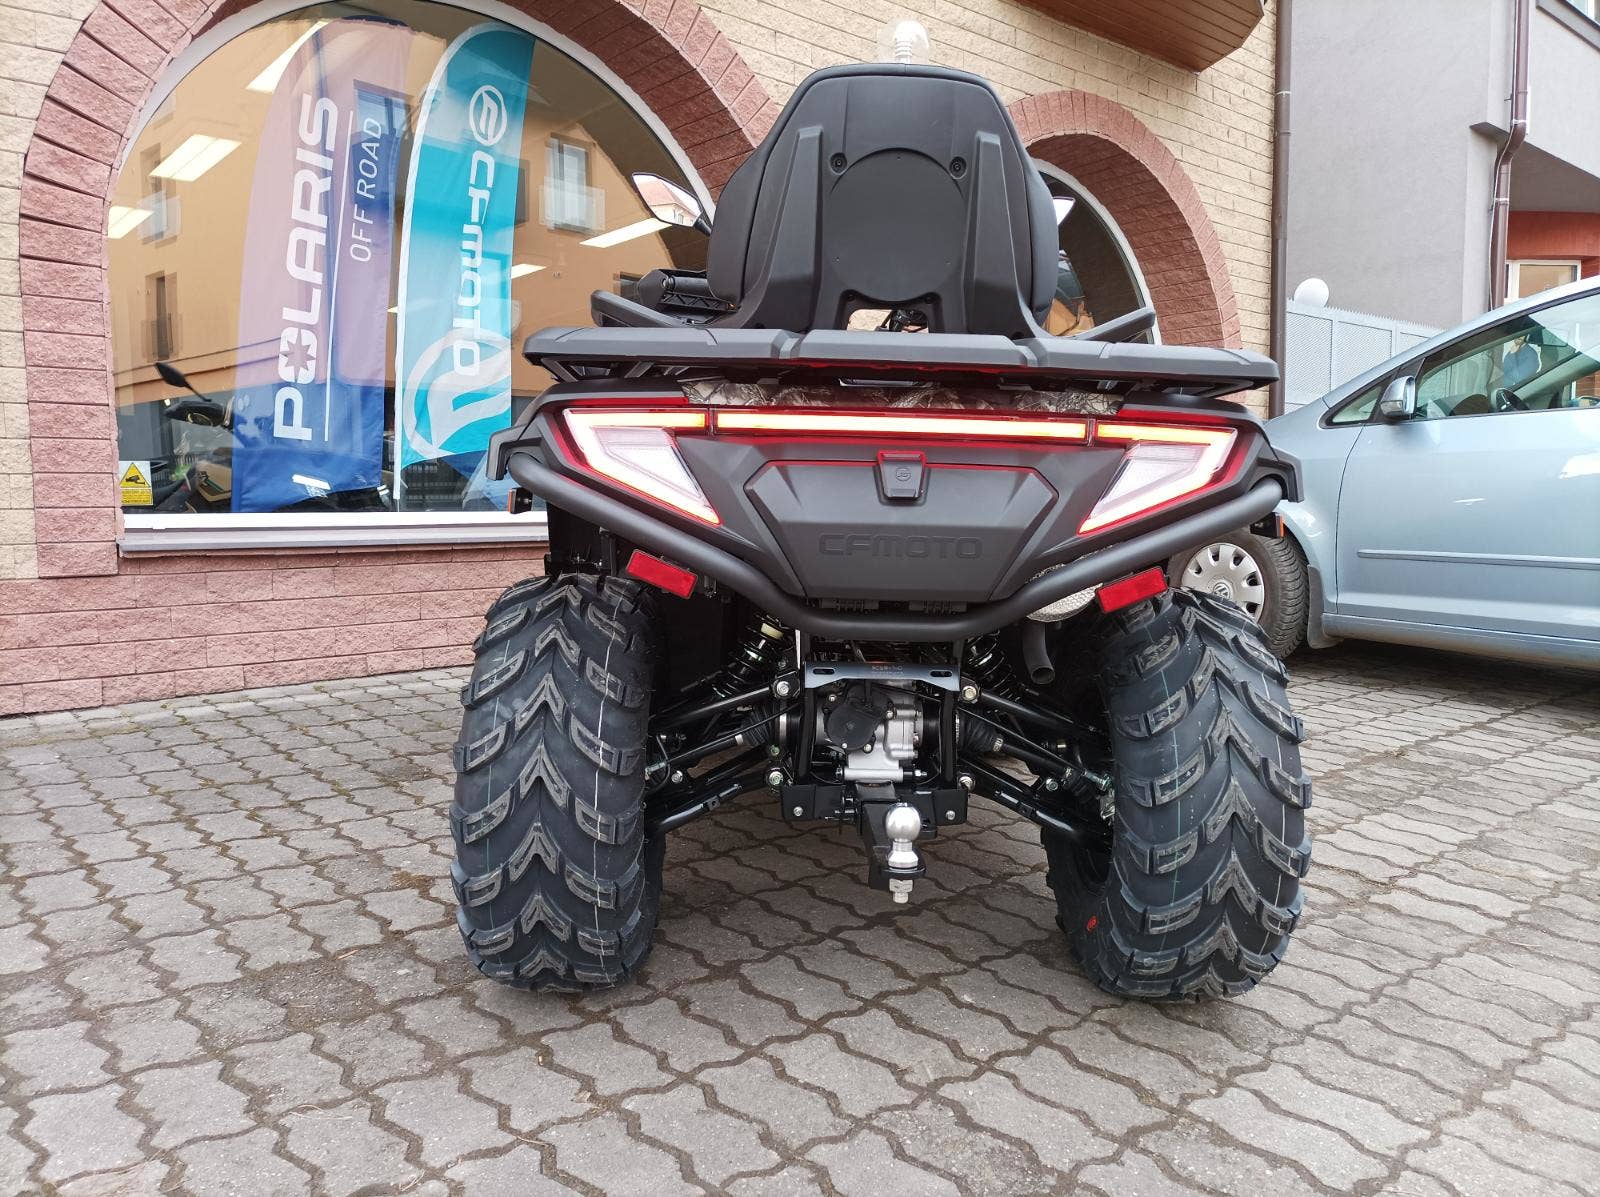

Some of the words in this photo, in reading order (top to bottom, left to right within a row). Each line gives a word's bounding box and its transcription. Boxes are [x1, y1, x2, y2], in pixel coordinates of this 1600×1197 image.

[356, 117, 382, 199] ROAD
[273, 93, 338, 441] POLARIS
[350, 204, 374, 262] OFF
[818, 532, 983, 559] CFMOTO
